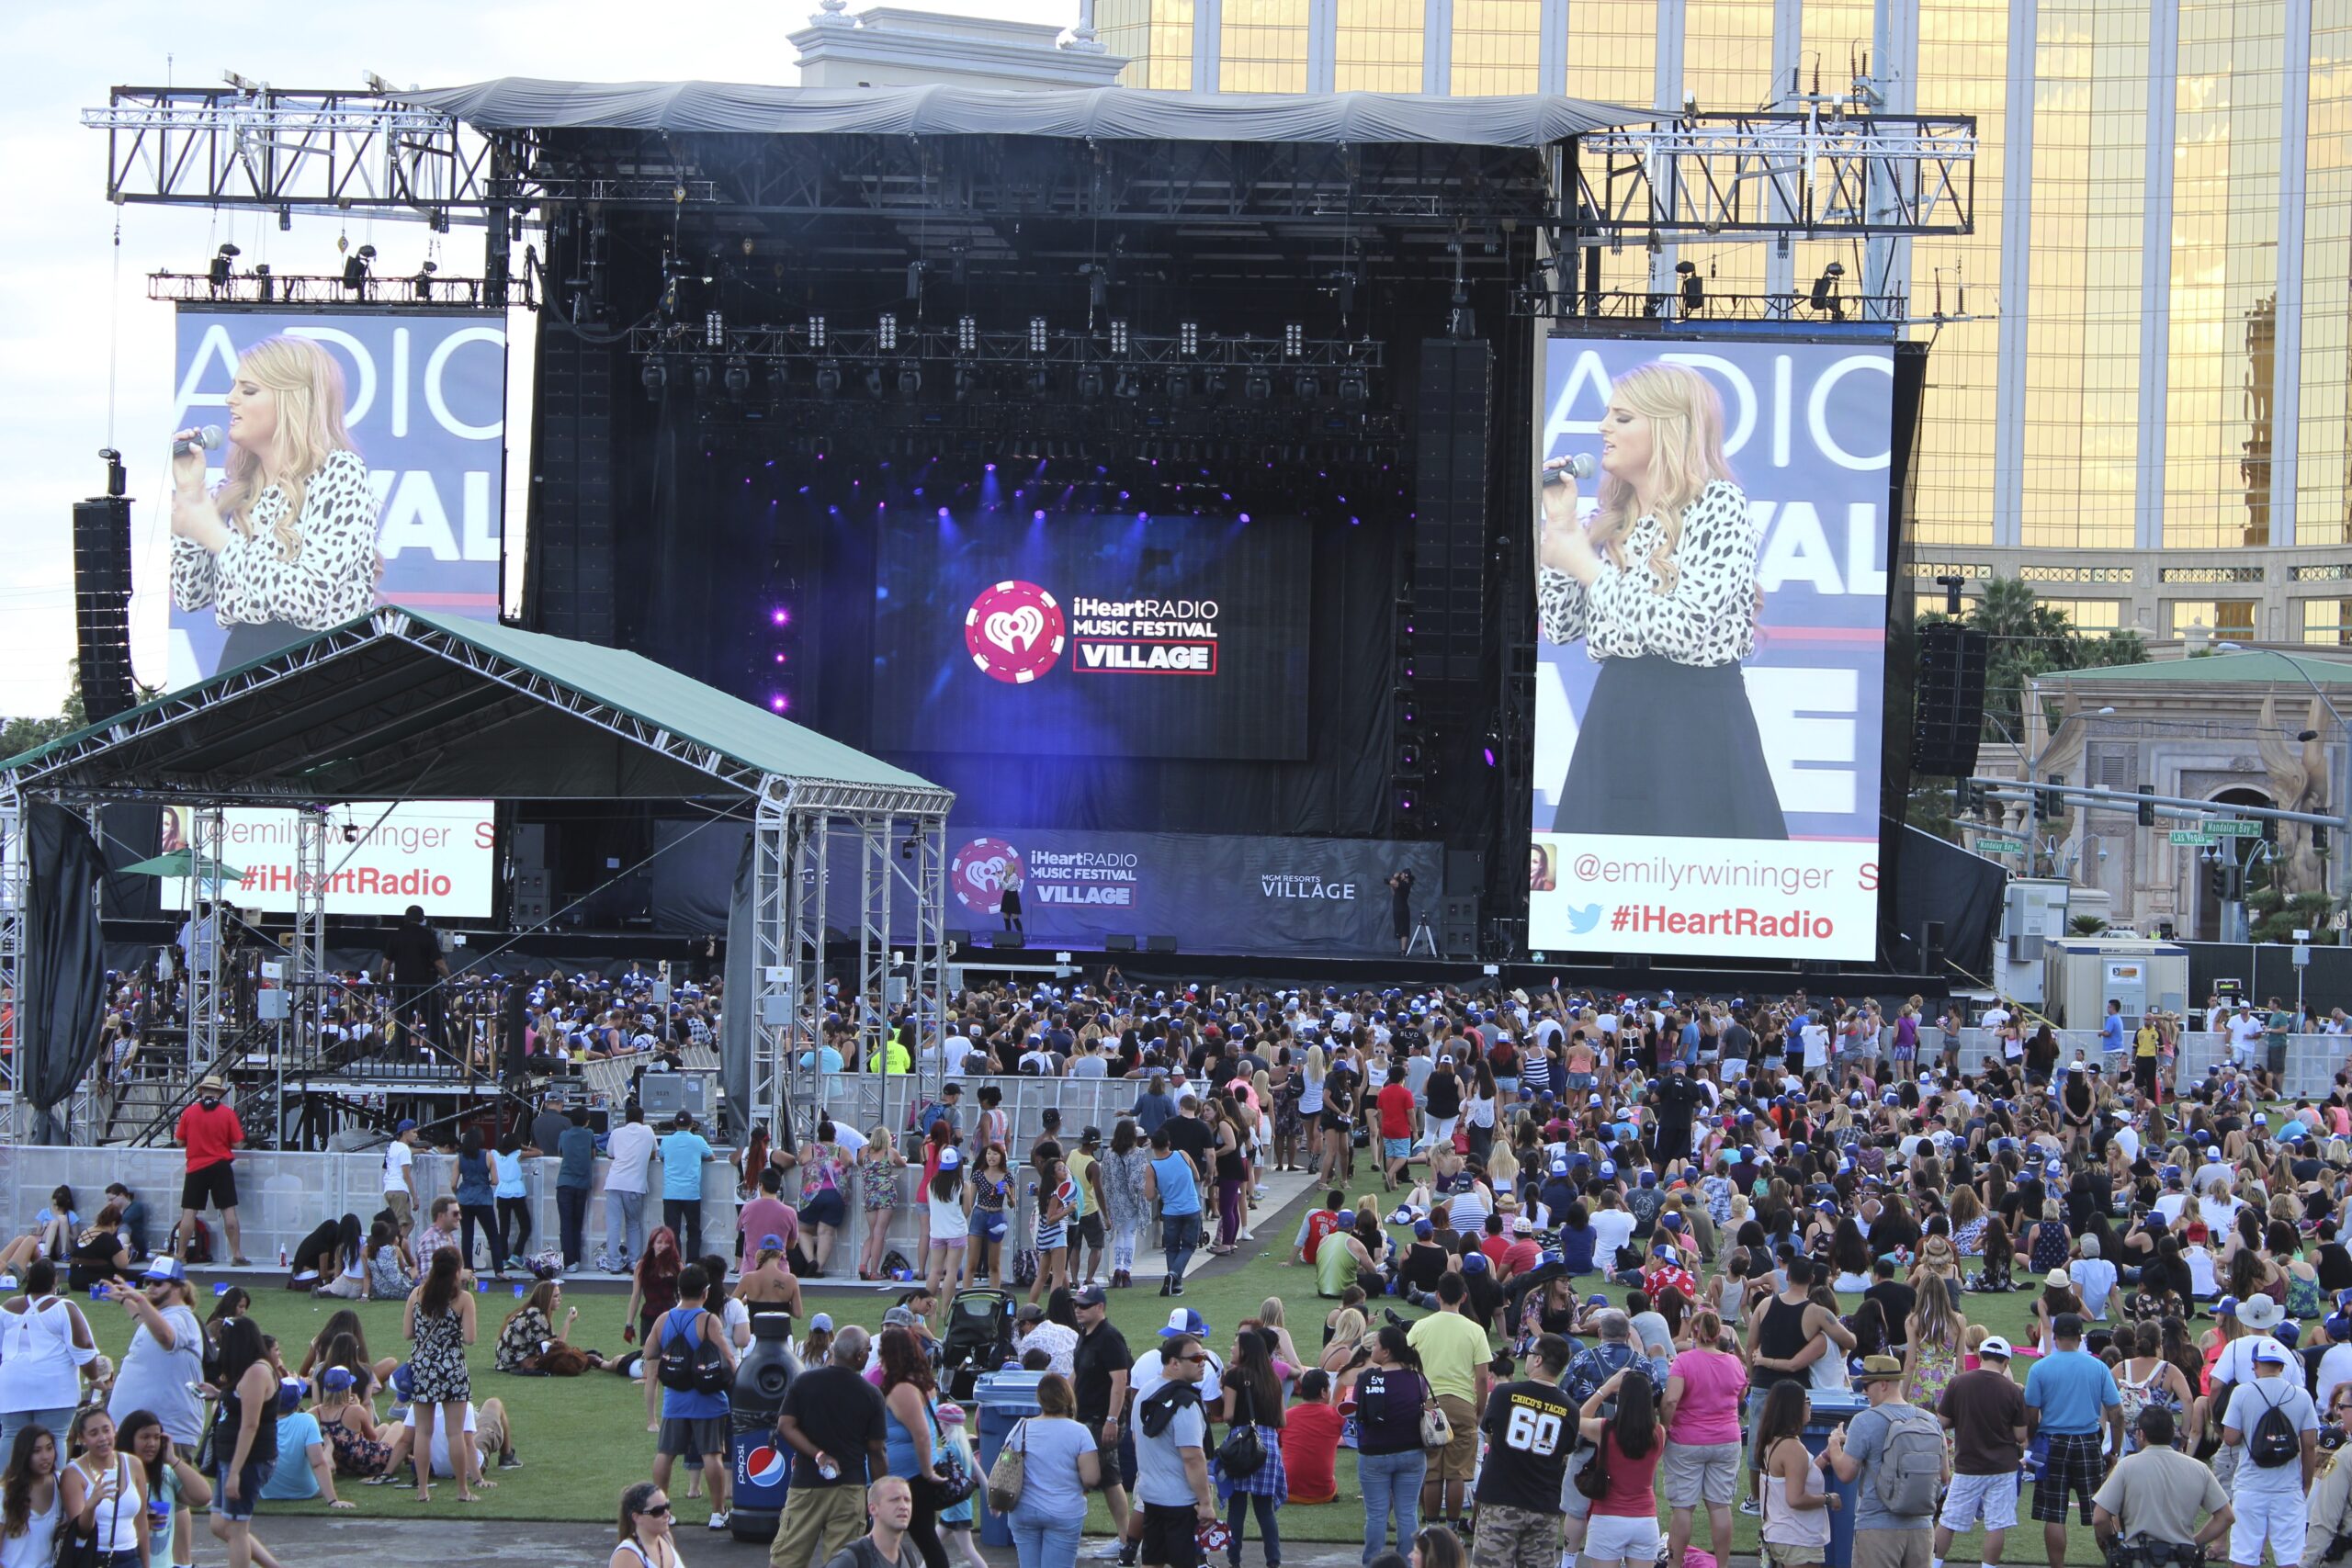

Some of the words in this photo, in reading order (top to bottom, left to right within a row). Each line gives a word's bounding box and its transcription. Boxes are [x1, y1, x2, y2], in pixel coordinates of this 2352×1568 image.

[1073, 597, 1219, 619] iHeartRADIO
[1073, 620, 1129, 636] MUSIC
[1132, 621, 1218, 637] FESTIVAL
[1081, 644, 1209, 670] VILLAGE
[2174, 832, 2185, 842] Las
[2187, 833, 2205, 844] Vegas
[2207, 822, 2235, 835] Mandalay
[2239, 823, 2250, 835] Bay
[1031, 850, 1137, 867] iHeartRADIO
[1031, 866, 1072, 879] MUSIC
[1074, 868, 1136, 881] FESTIVAL
[1574, 853, 1834, 895] @emilyrwininger
[1036, 886, 1130, 905] VILLAGE
[1261, 881, 1355, 899] VILLAGE
[1611, 905, 1834, 939] #iHeartRadio
[1511, 1393, 1543, 1409] CHICO'S
[1544, 1402, 1567, 1416] TACOS
[1505, 1405, 1563, 1456] 60
[737, 1443, 746, 1484] pepsi
